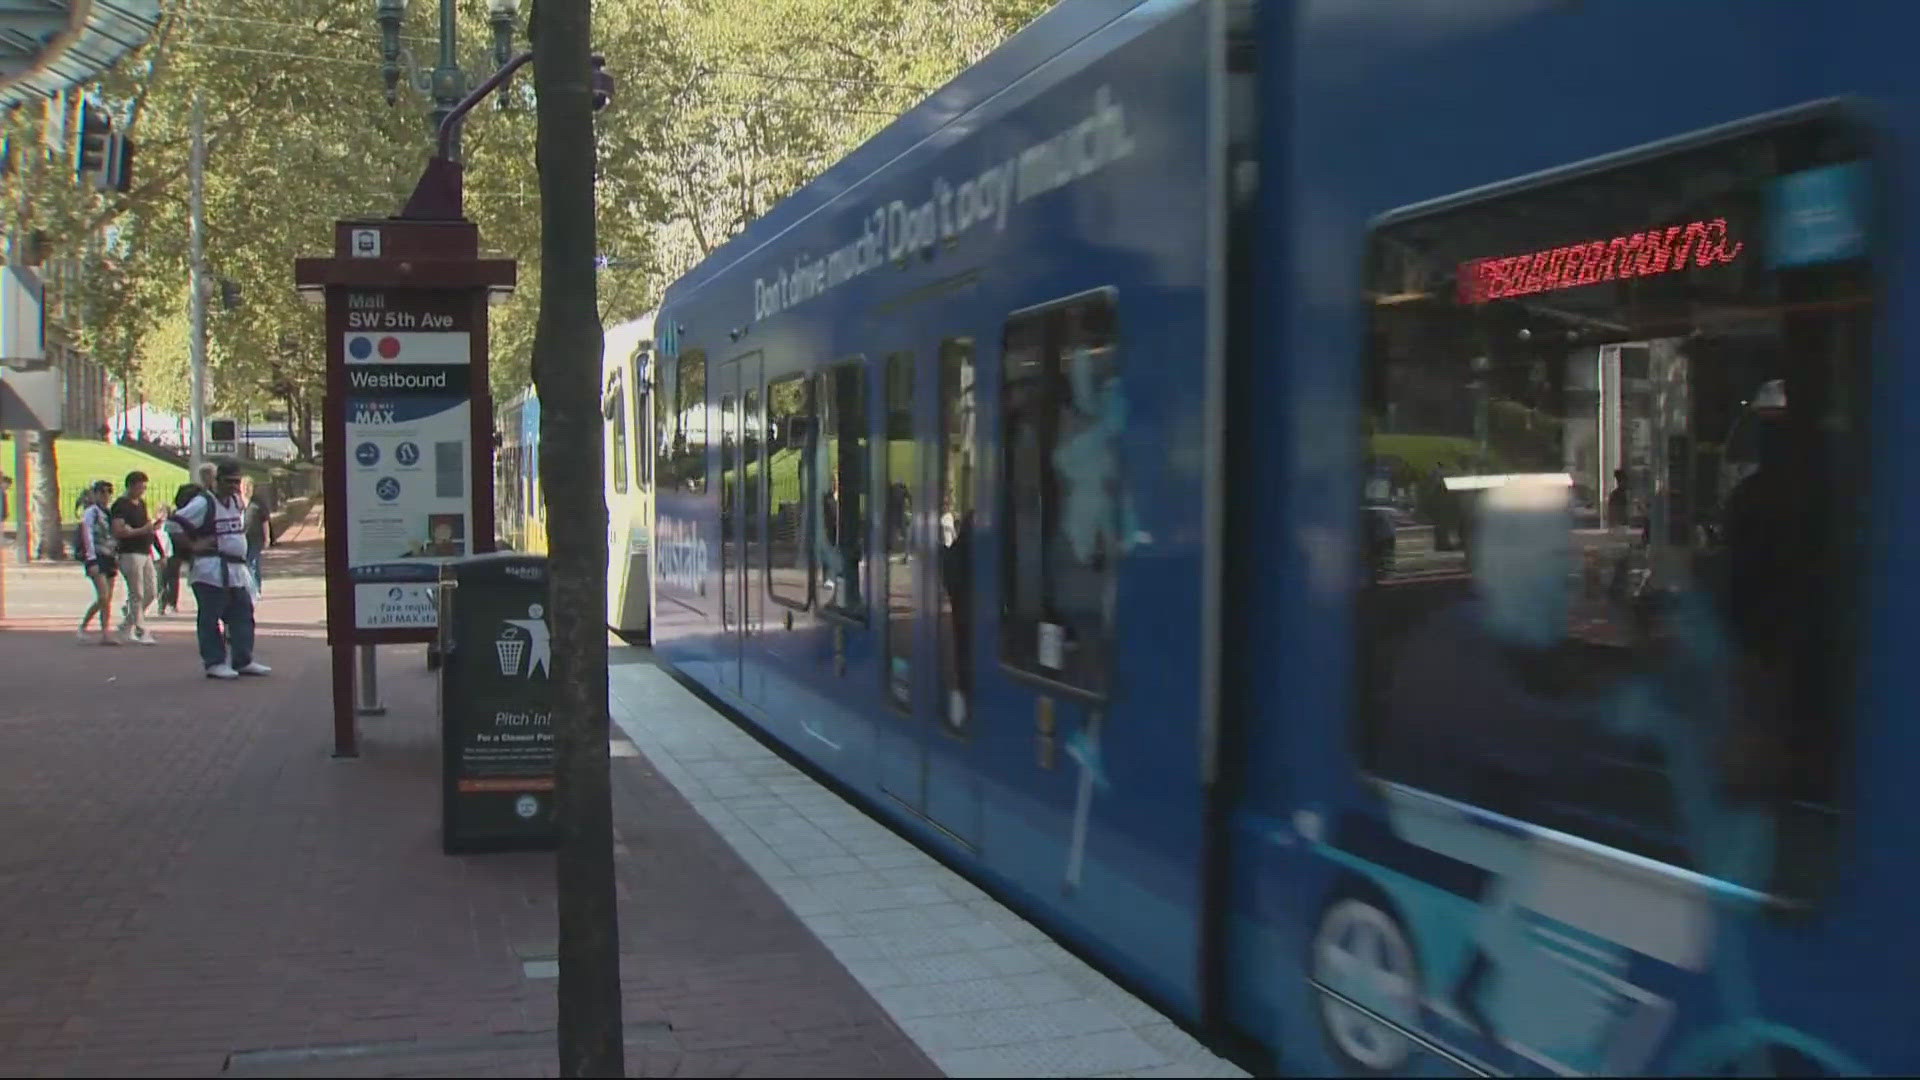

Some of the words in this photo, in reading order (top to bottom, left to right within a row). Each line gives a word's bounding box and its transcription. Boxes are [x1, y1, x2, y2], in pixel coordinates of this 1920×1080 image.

[349, 294, 384, 309] Mall
[349, 312, 379, 327] SW
[384, 312, 415, 327] 5th
[421, 312, 454, 327] Ave
[351, 371, 446, 388] Westbound
[355, 410, 395, 425] MAX
[381, 612, 393, 625] all
[396, 613, 419, 624] MAX
[496, 711, 530, 726] Pitch
